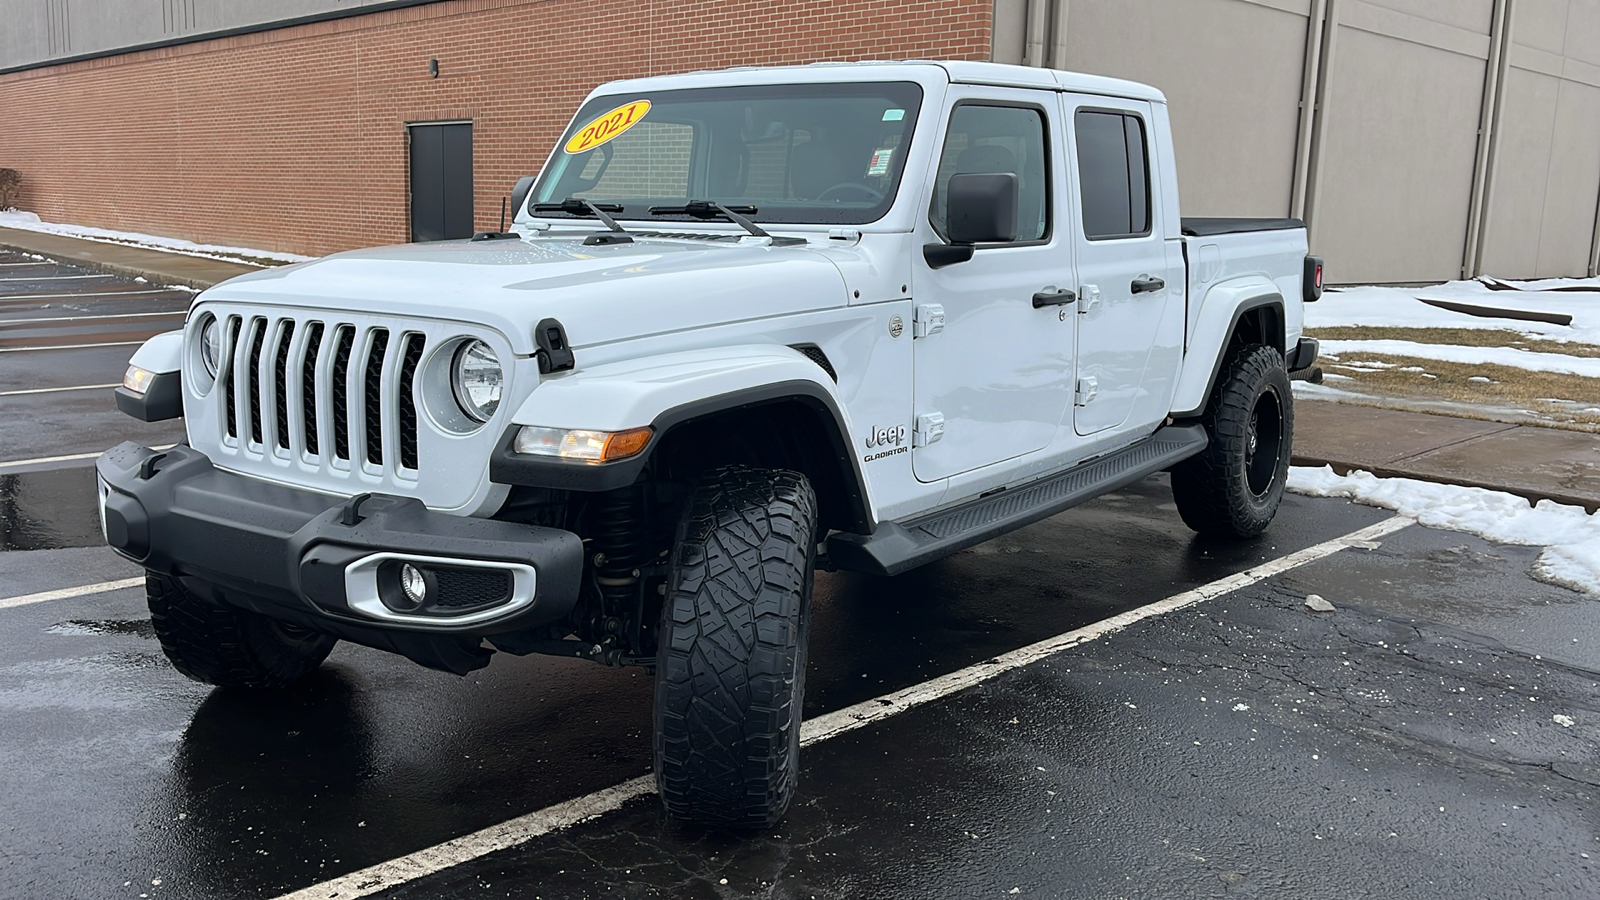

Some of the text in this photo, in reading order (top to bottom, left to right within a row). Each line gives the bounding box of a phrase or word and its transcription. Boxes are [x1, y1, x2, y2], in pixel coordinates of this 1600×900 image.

[579, 105, 637, 149] 2021
[865, 424, 906, 448] Jeep
[863, 446, 908, 462] GLADIATOR
